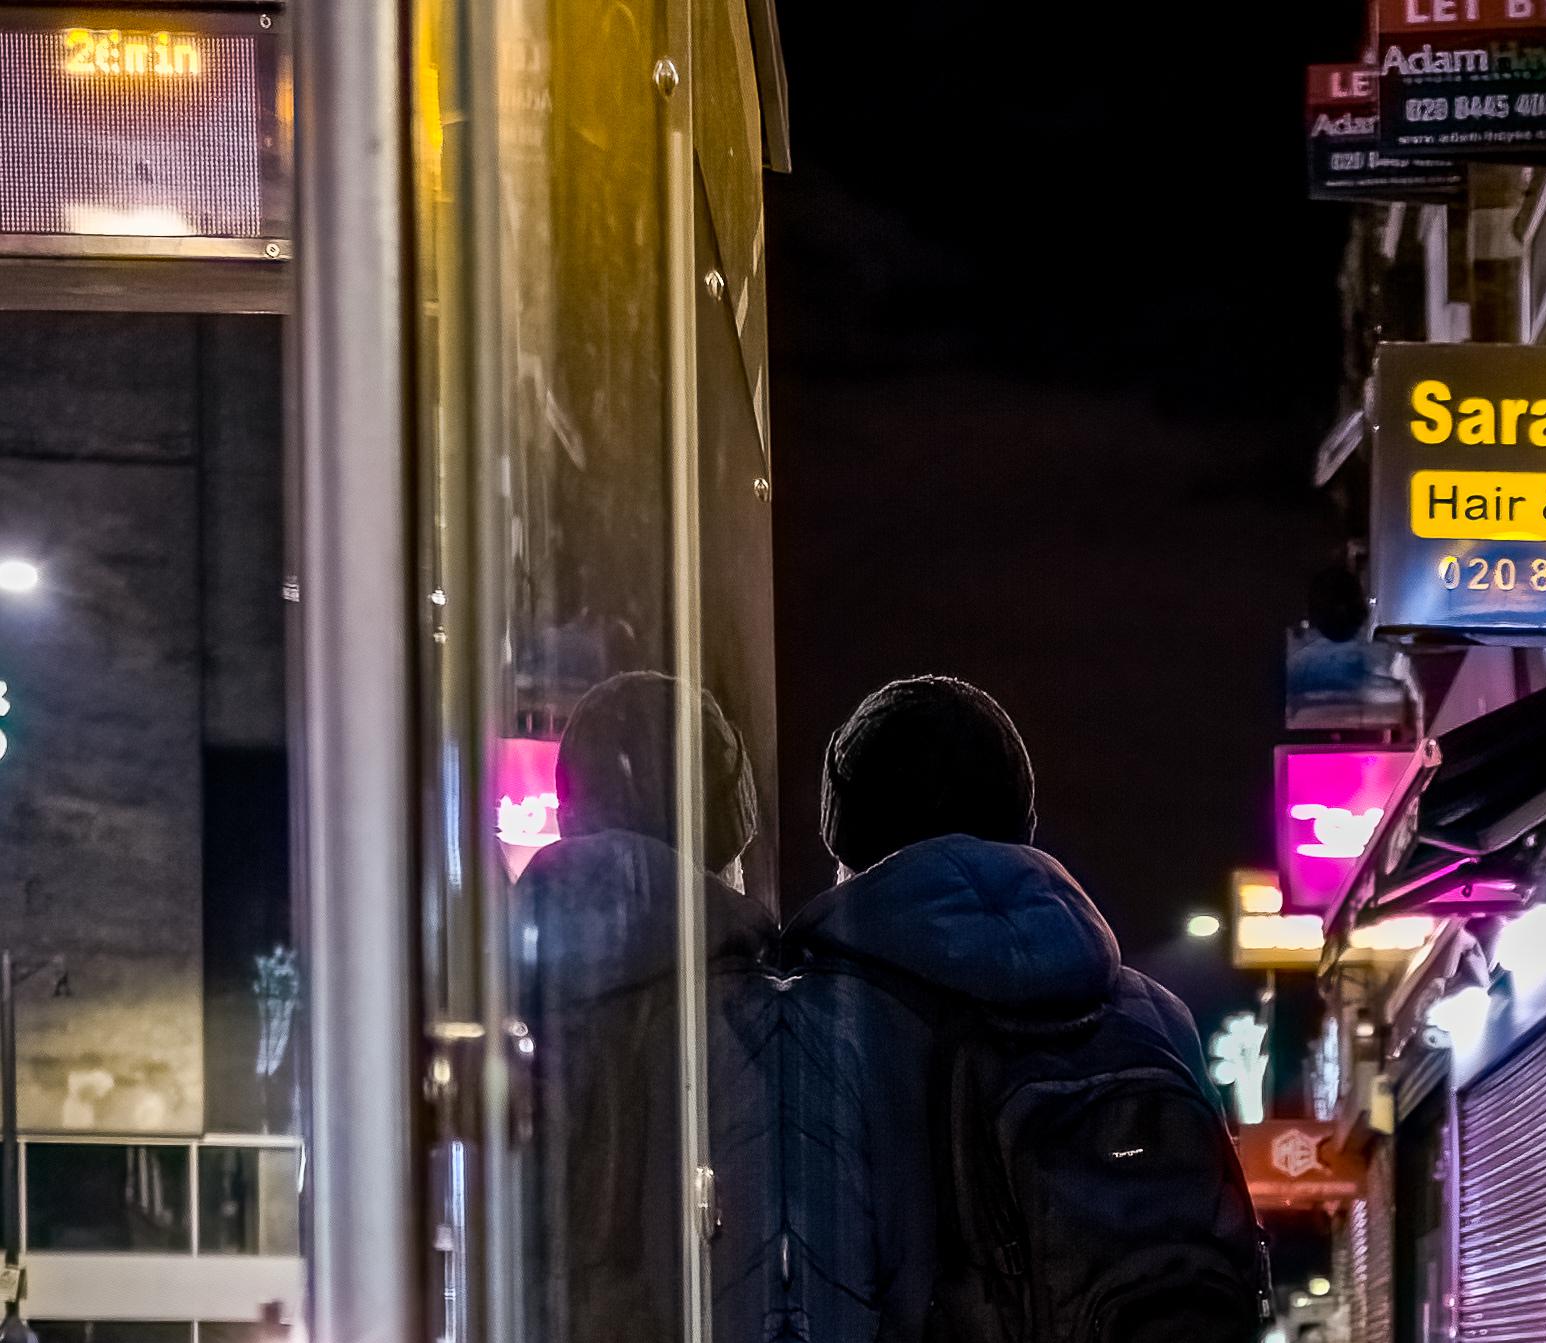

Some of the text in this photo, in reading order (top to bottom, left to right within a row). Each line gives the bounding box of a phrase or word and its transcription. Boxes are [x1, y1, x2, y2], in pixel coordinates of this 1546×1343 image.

[1330, 71, 1377, 98] LE
[1428, 484, 1527, 522] Hair
[1438, 555, 1516, 592] 020
